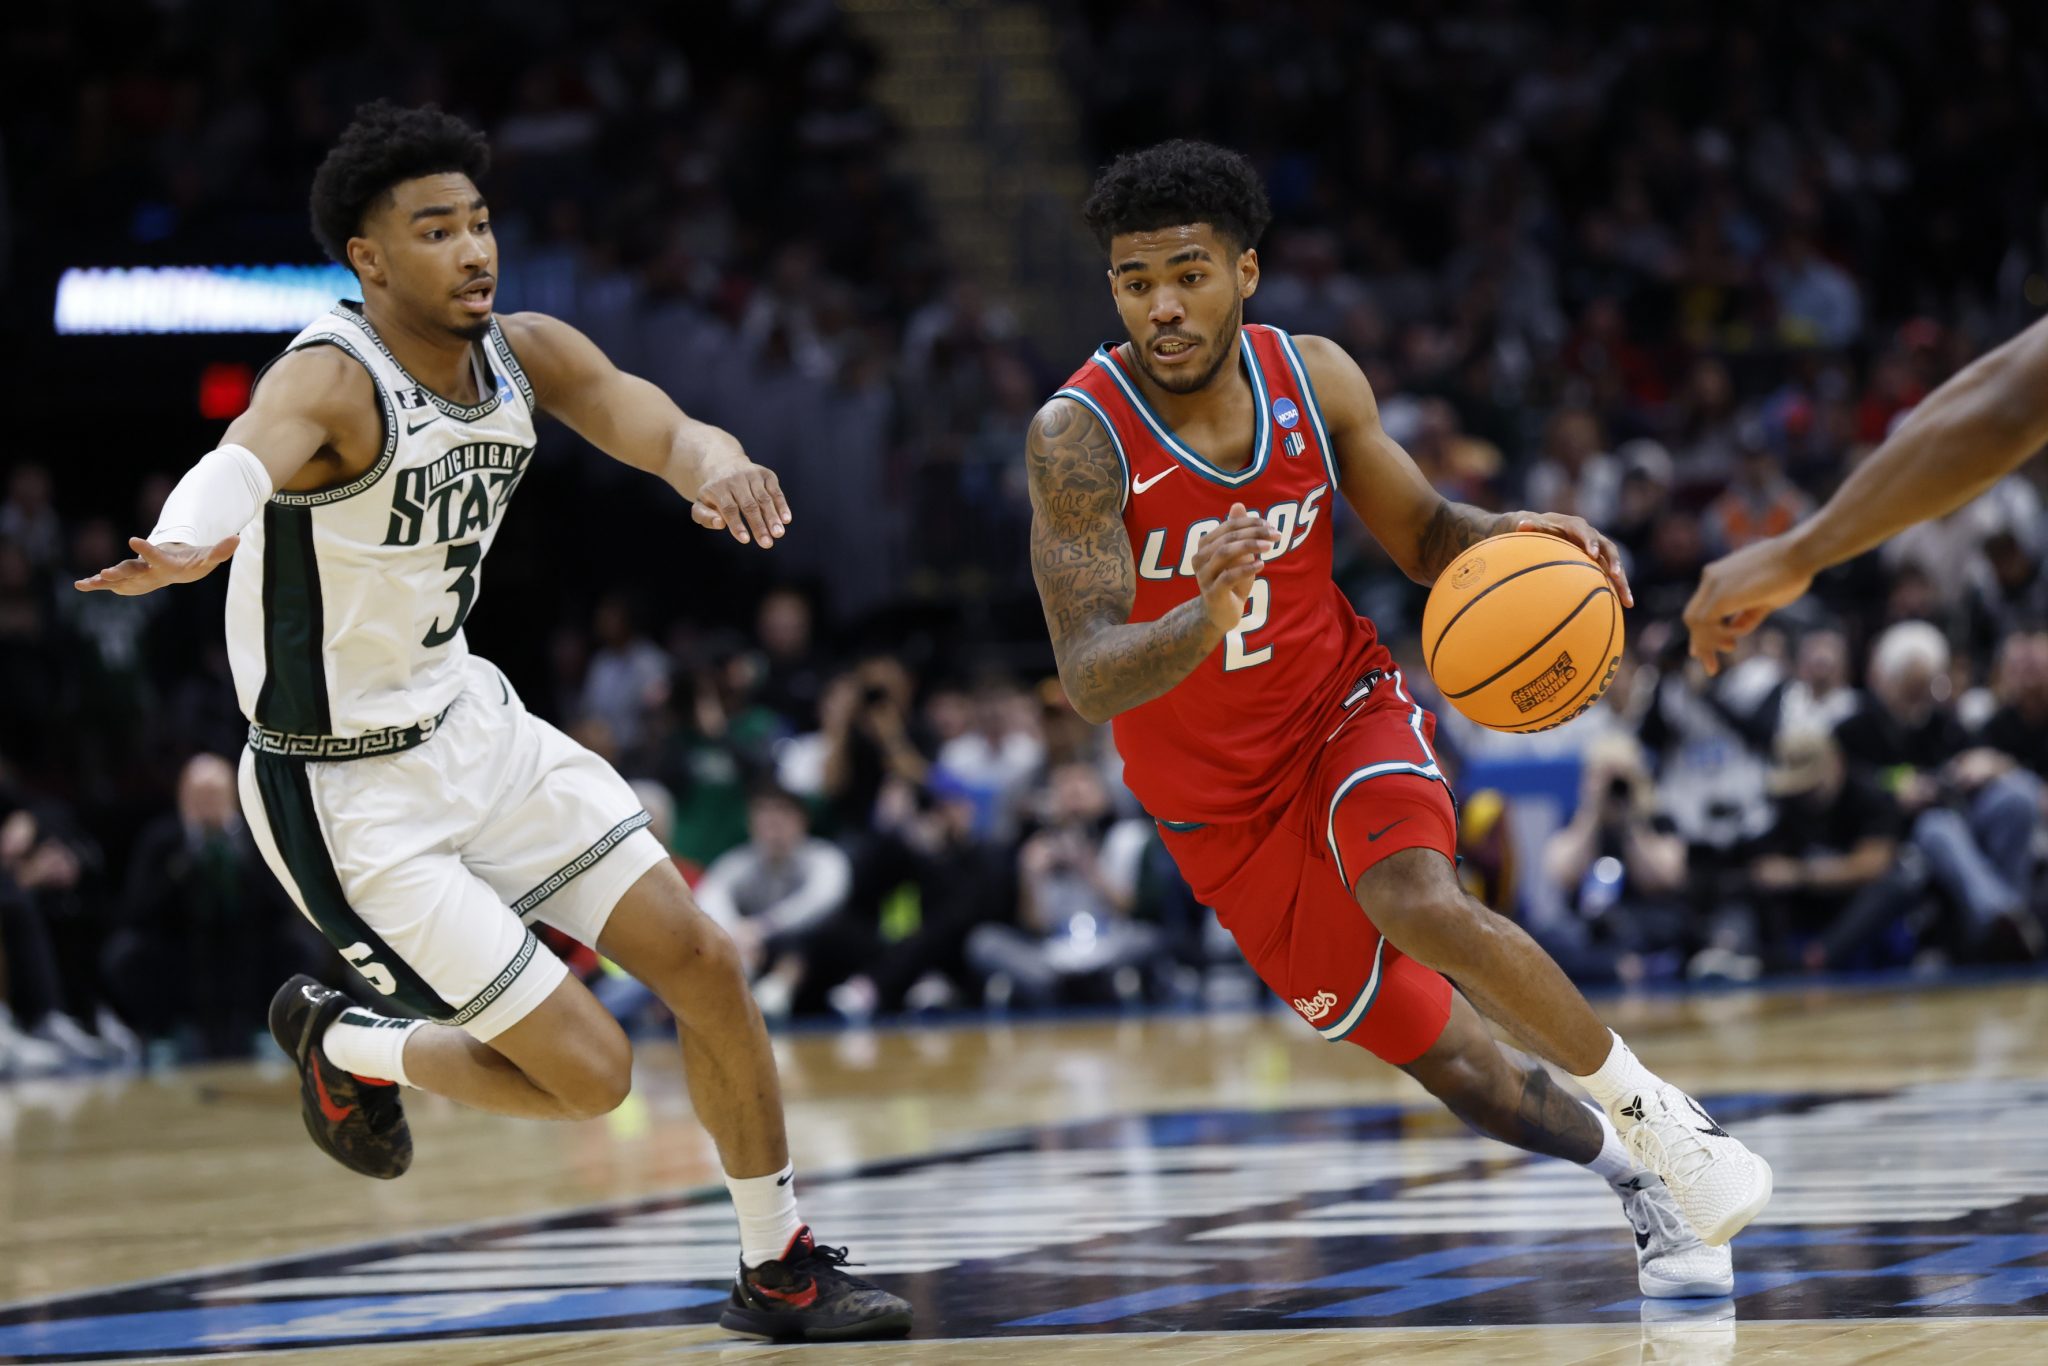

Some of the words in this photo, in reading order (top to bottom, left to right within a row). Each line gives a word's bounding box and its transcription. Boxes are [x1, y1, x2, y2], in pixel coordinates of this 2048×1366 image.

[1278, 408, 1298, 424] NCAA
[380, 466, 520, 546] STAT
[1139, 482, 1328, 580] LOOS
[421, 541, 482, 648] 3
[1224, 577, 1274, 671] 2
[1512, 670, 1558, 705] MADNESS
[1534, 674, 1568, 704] MARCH
[1293, 989, 1338, 1023] Lobos
